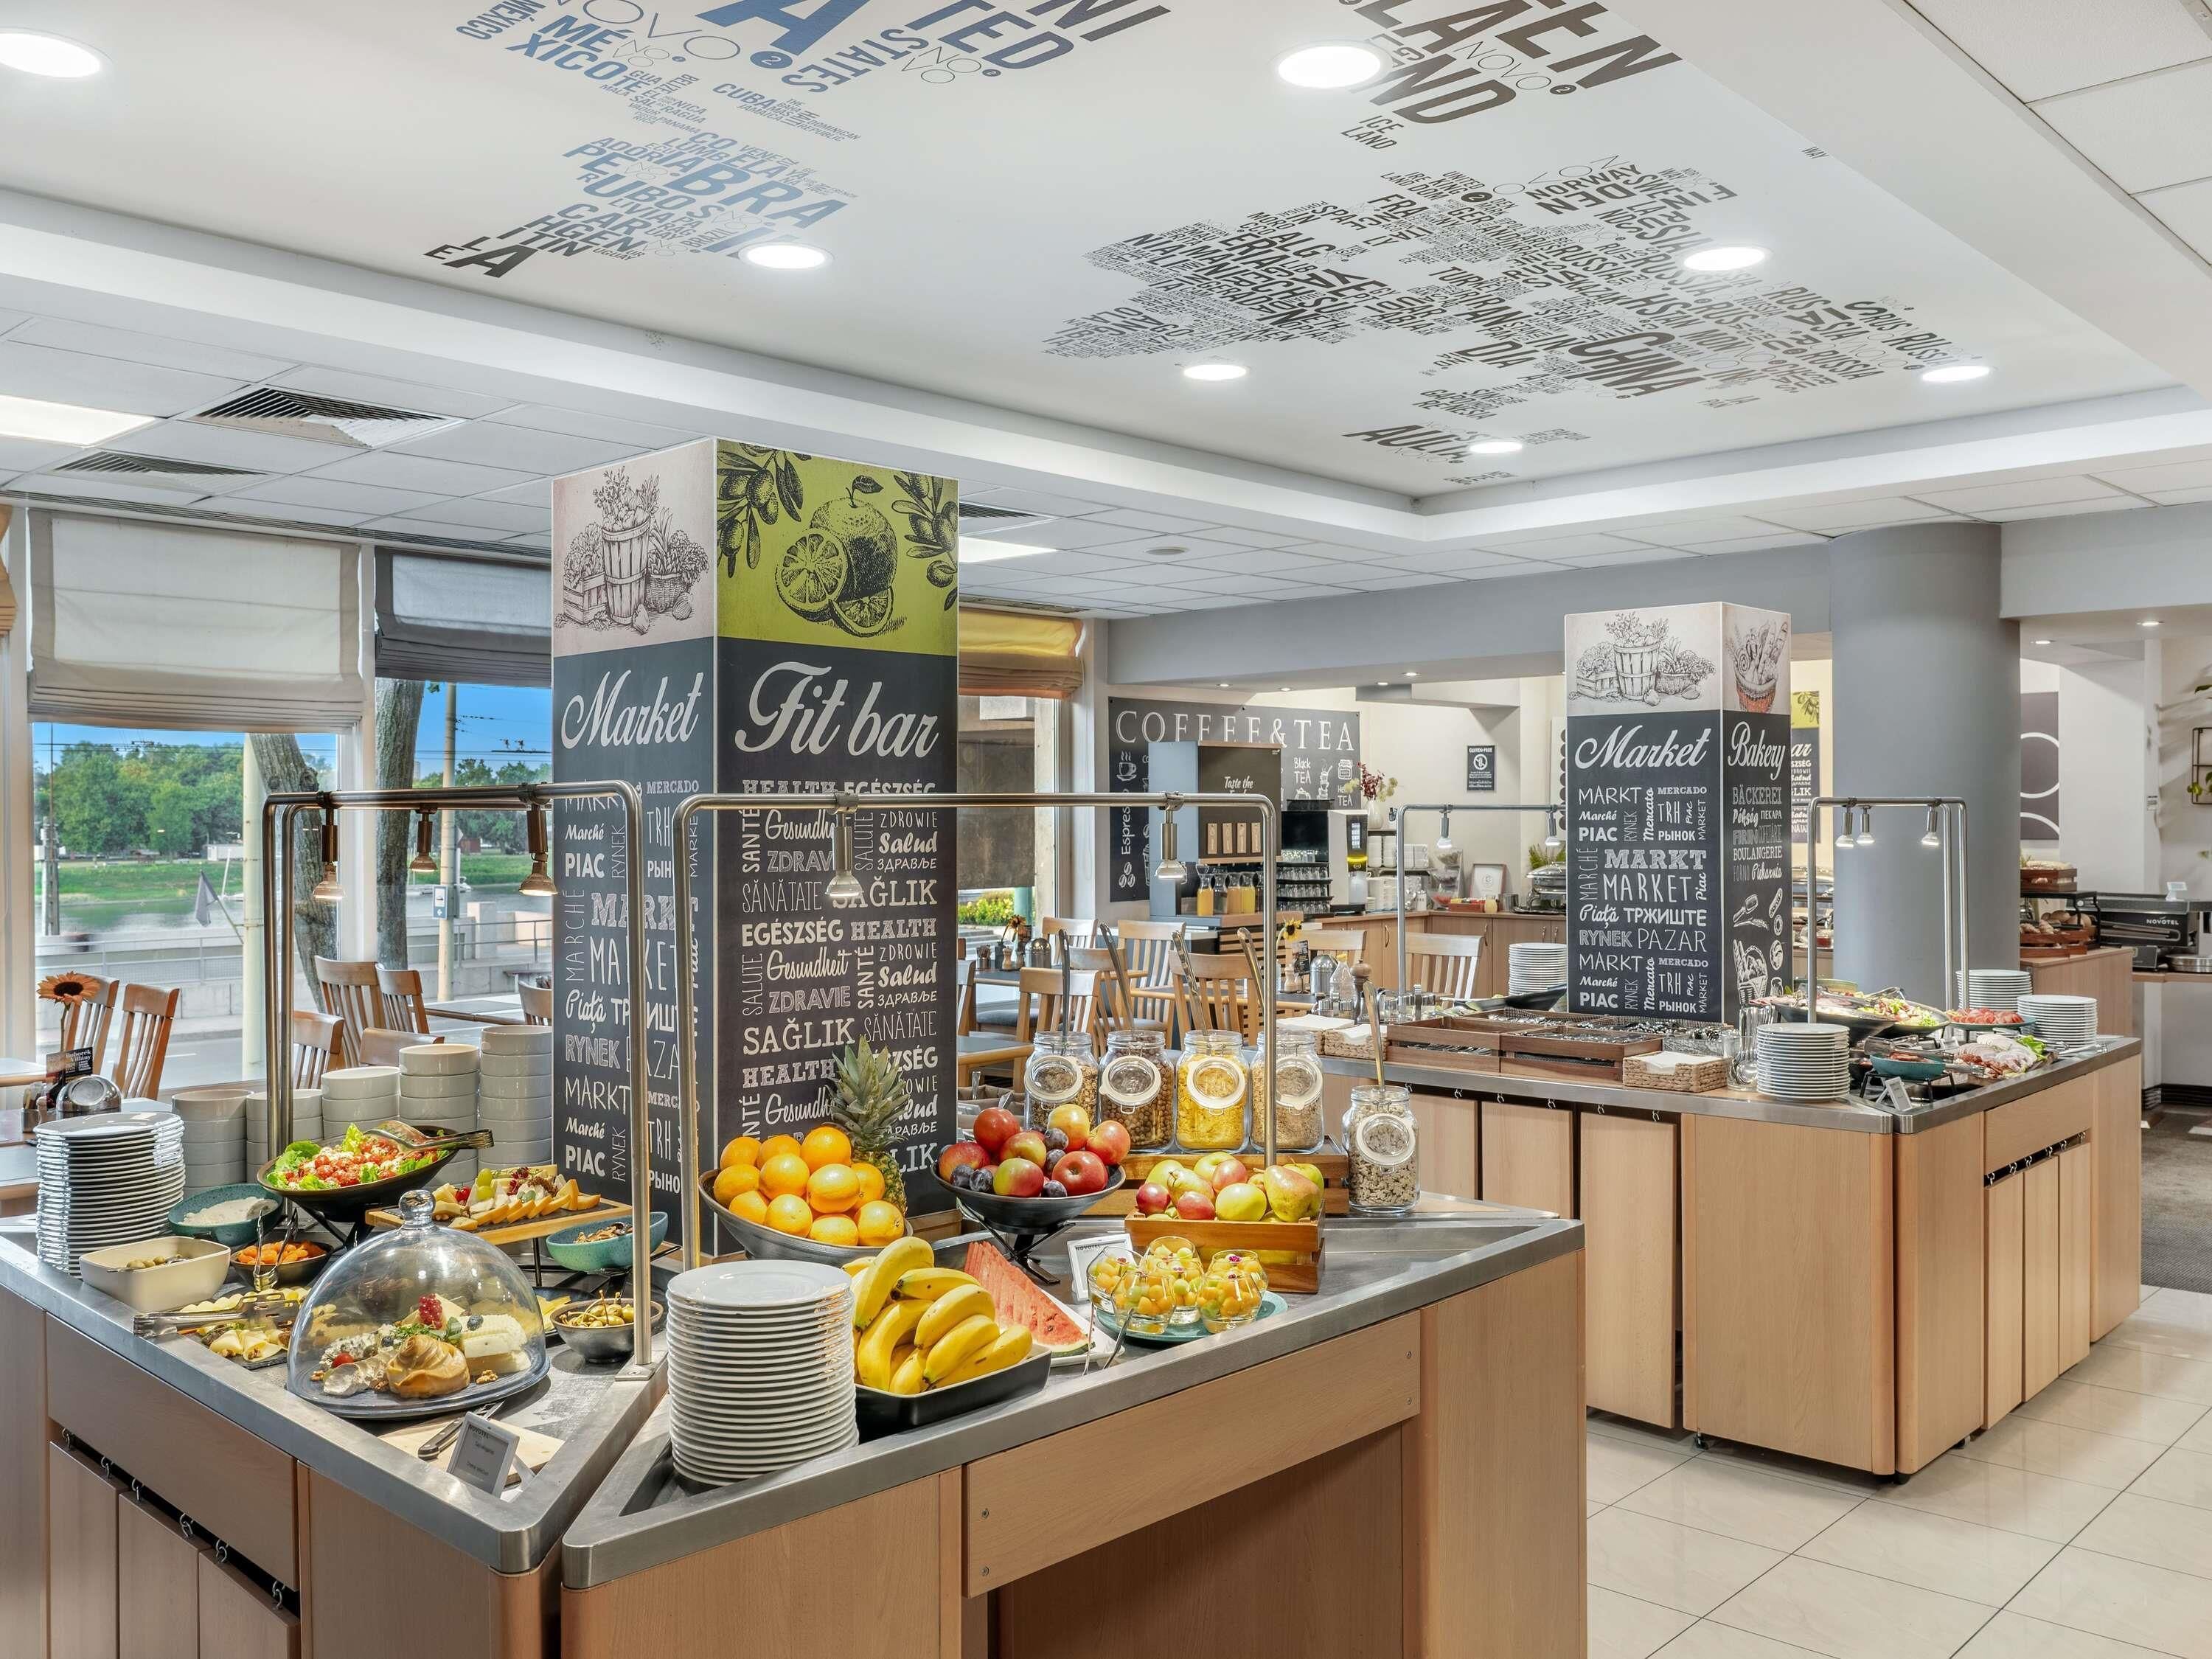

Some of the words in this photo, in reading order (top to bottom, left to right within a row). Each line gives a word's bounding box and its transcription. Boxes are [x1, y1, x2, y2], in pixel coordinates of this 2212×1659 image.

[712, 83, 777, 108] CUBA
[1525, 164, 1642, 200] NORWAY
[561, 668, 704, 749] Market
[735, 661, 848, 757] Fit
[847, 681, 939, 758] bar
[1574, 725, 1711, 769] Market
[1728, 721, 1786, 780] Bakery
[647, 780, 699, 794] MERCADO
[1294, 771, 1312, 784] TEA
[1658, 786, 1707, 795] MERCADO
[1338, 794, 1353, 807] TEA
[1579, 785, 1641, 804] MARKT
[1733, 785, 1781, 804] BÄCKEREI
[765, 809, 835, 841] Gesundh
[880, 811, 938, 828] ZDROWIE
[1579, 810, 1617, 821] Marché
[1624, 810, 1638, 841] RYNEK
[1643, 787, 1655, 841] Mercato
[1658, 801, 1680, 824] TRH
[1686, 801, 1694, 824] PIAC
[1698, 799, 1706, 841] MARKET
[565, 823, 605, 841] Marché
[854, 812, 874, 871] SALUTE
[878, 831, 938, 854] Salud
[1579, 827, 1618, 842] PIAC
[1658, 830, 1696, 842] РЫНОК
[611, 824, 625, 878] RYNEK
[689, 815, 698, 877] MARKE
[1733, 846, 1782, 860] BOULANGERIE
[565, 852, 605, 879] PIAC
[647, 860, 672, 878] РЫН
[767, 850, 834, 873] ZDRAV
[1604, 849, 1707, 870] MARKT
[1576, 847, 1598, 901] MARCHÉ
[1603, 872, 1692, 902] MARKET
[1696, 872, 1706, 901] Piac
[1624, 907, 1707, 927] ТРЖИШТЕ
[563, 888, 584, 981] MARCHÉ
[742, 917, 844, 947] EGÉSZSÉG
[850, 918, 936, 941] HEALTH
[1579, 929, 1633, 948] RYNEK
[1638, 928, 1707, 953] PAZAR
[767, 946, 852, 981] Gesundheit
[879, 942, 937, 961] ZDROWIE
[1579, 951, 1643, 973] MARKT
[1658, 958, 1708, 968] MERCADO
[742, 953, 762, 1016] SALUTE
[855, 945, 874, 1009] SANTÉ
[877, 961, 937, 987] Salud
[1579, 976, 1618, 988] Marché
[1644, 956, 1655, 1011] Mercato
[1659, 972, 1681, 996] TRH
[768, 985, 850, 1014] ZDRAVIE
[1579, 992, 1618, 1009] PIAC
[1625, 978, 1638, 1010] RYNEK
[1699, 973, 1708, 1014] MARKET
[1659, 1001, 1697, 1013] РЫНОК
[742, 1017, 855, 1055] SAĞLIK
[566, 1034, 620, 1069] RYNEK
[742, 1058, 837, 1088] HEALTH
[566, 1075, 630, 1115] MARKT
[566, 1116, 605, 1139] Marché
[566, 1144, 606, 1178] PIAC
[612, 1126, 626, 1182] RYNEK
[649, 1169, 681, 1194] РЫНО
